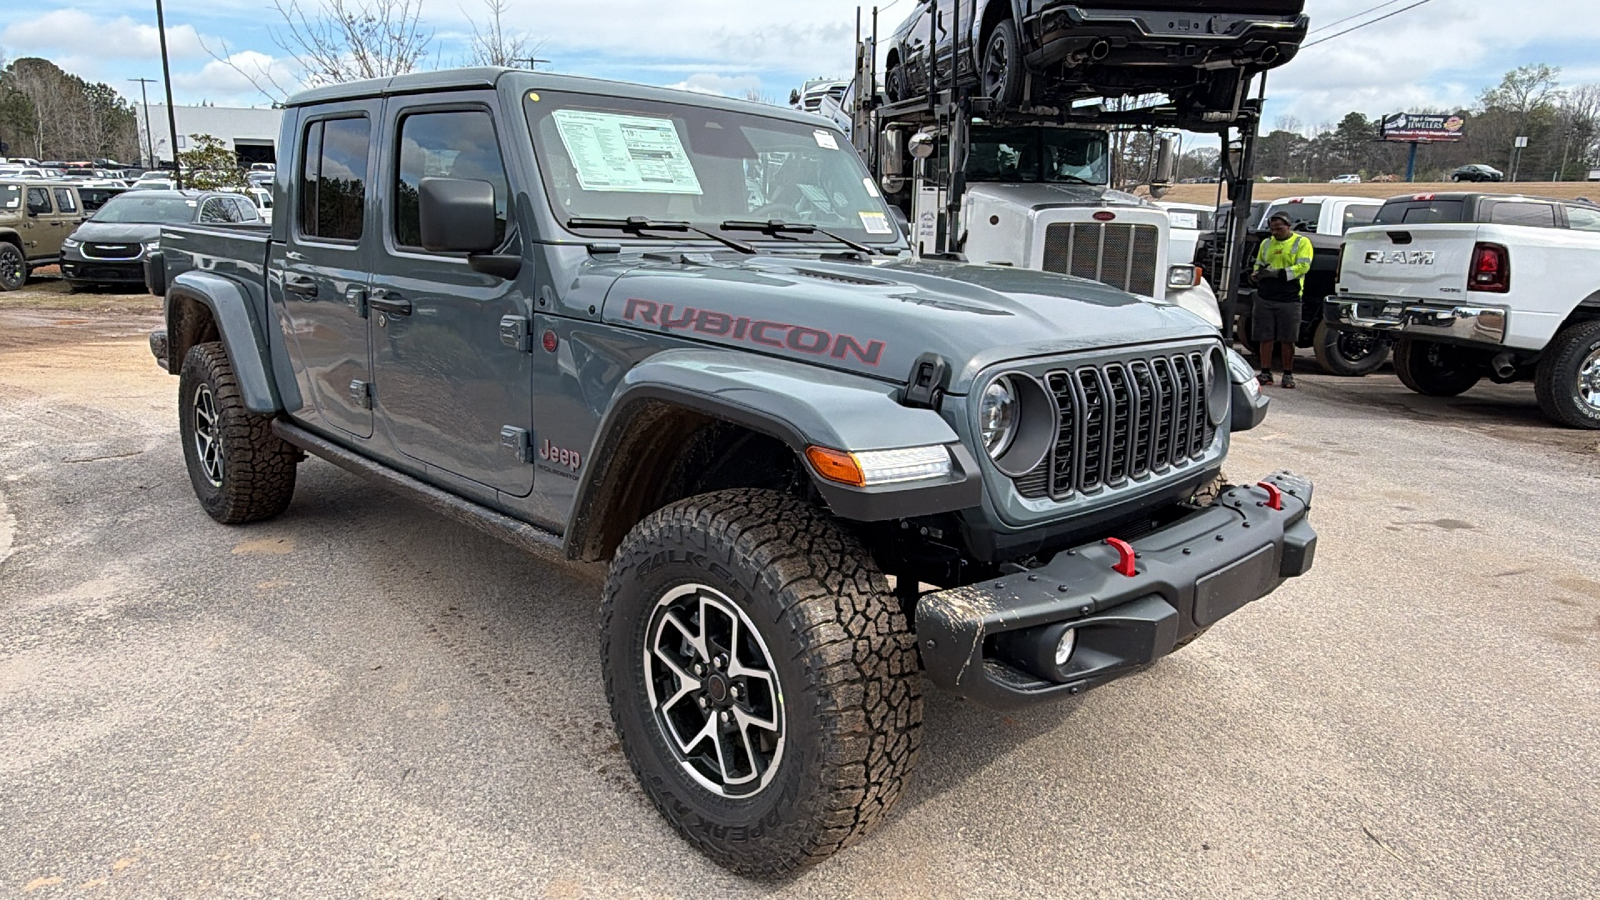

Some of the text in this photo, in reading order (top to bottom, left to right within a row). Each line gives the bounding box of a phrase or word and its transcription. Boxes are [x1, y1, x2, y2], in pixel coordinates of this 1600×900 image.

[1364, 250, 1435, 266] RAM
[622, 298, 887, 367] RUBICON
[538, 438, 582, 473] Jeep
